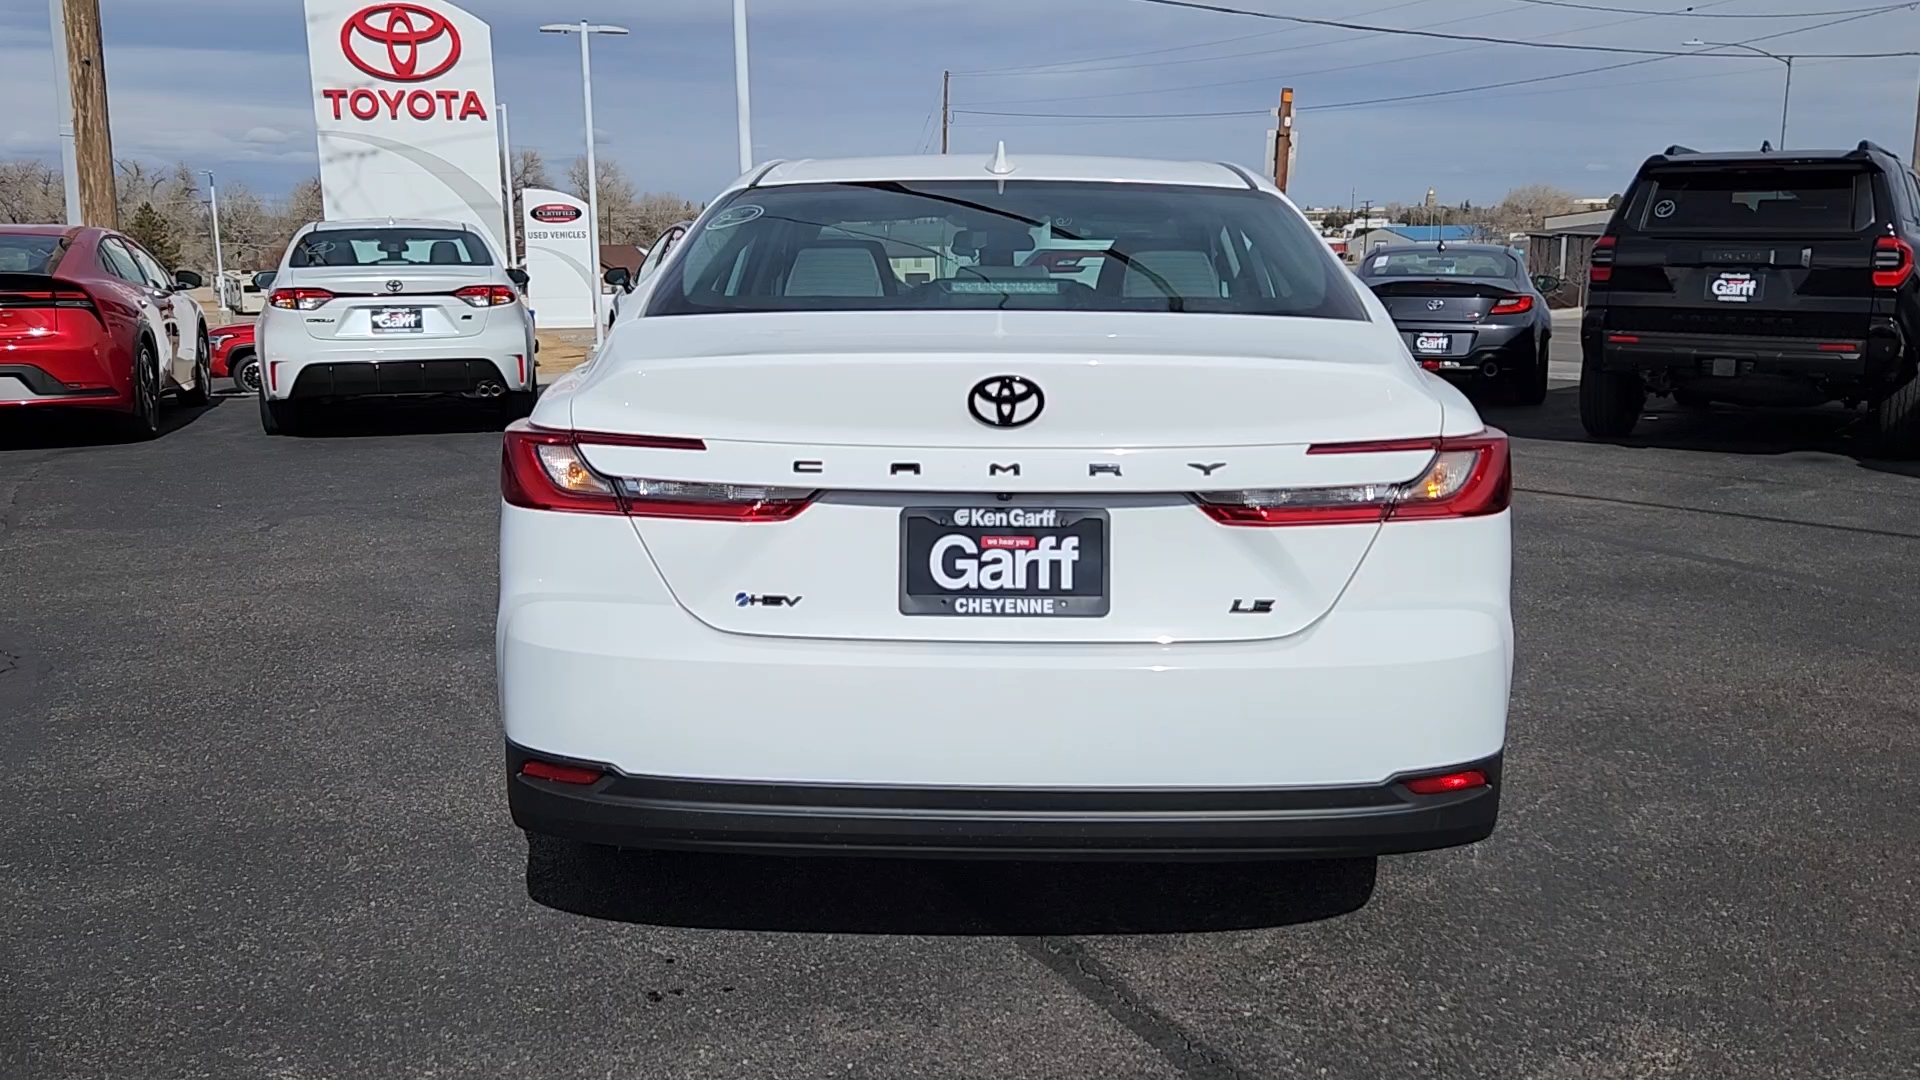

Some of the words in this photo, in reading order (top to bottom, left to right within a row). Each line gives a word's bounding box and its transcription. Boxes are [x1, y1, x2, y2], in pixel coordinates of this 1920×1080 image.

[323, 89, 488, 121] TOYOTA
[528, 231, 548, 239] USED
[550, 230, 587, 239] VEHICLES
[1712, 279, 1757, 296] Garff
[1416, 336, 1449, 349] Garff
[793, 461, 1227, 477] CAMRY
[971, 509, 1007, 527] Ken
[1009, 508, 1057, 527] Garff
[999, 537, 1015, 546] hear
[1016, 539, 1030, 548] you
[929, 534, 1080, 590] Garff
[955, 598, 1055, 614] CHEYENNE
[1228, 599, 1276, 613] LE
